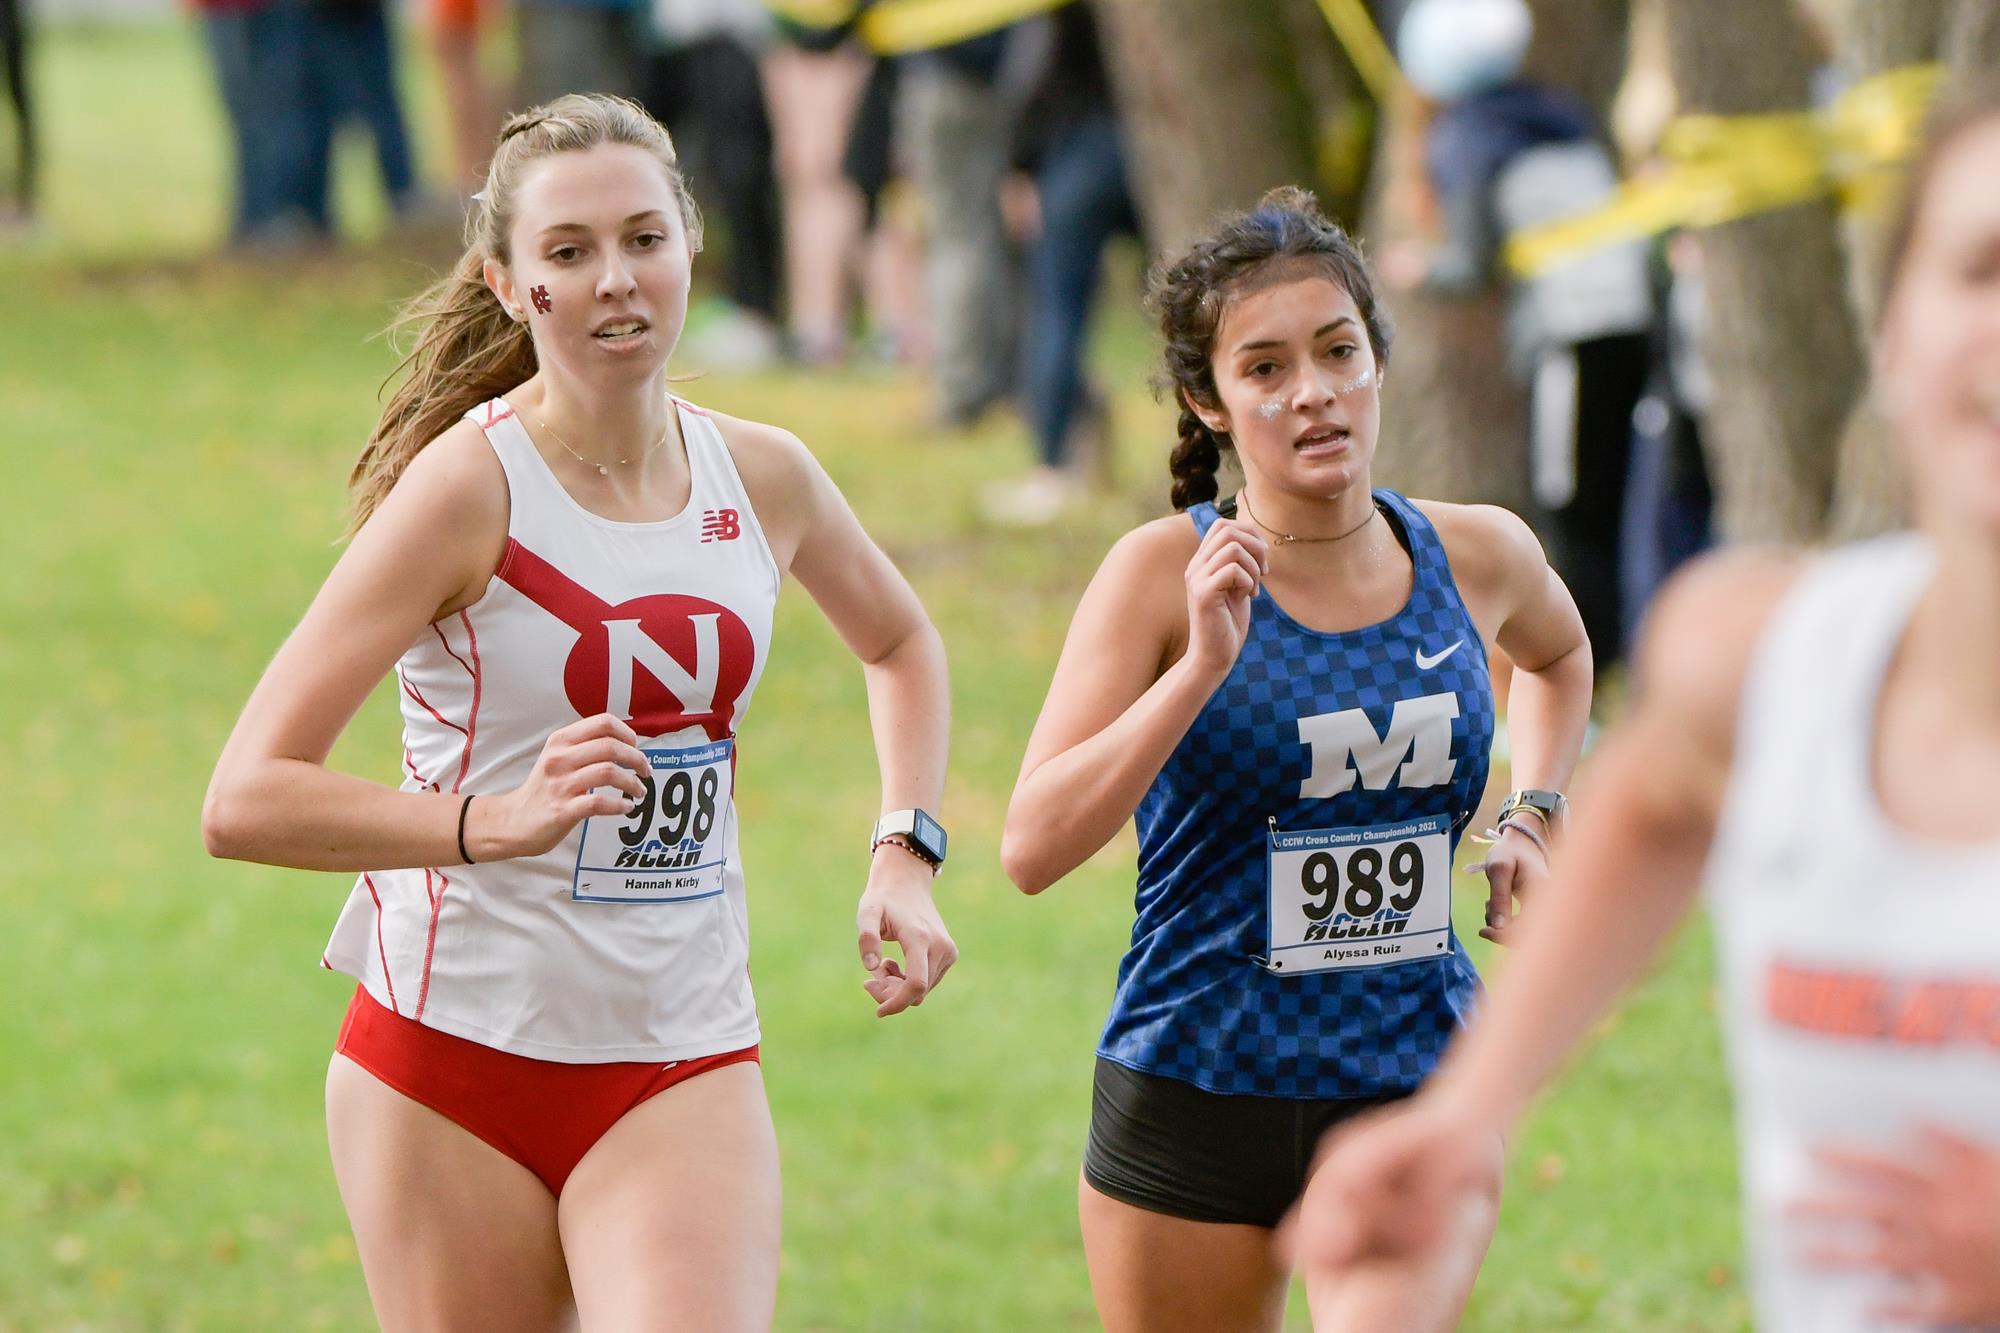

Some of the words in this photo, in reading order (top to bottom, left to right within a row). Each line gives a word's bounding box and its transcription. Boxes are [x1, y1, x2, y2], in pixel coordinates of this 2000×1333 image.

[601, 613, 721, 721] N
[653, 754, 681, 765] Country
[1297, 692, 1460, 799] M
[618, 767, 718, 846] 998
[1282, 836, 1304, 847] CCIW
[1305, 835, 1328, 845] Cross
[1330, 832, 1361, 843] Country
[1363, 825, 1417, 841] Championship
[1418, 821, 1437, 832] 2021
[625, 878, 672, 889] Hannah
[675, 876, 699, 888] Kirby
[1301, 842, 1424, 920] 989
[1324, 946, 1369, 960] Alyssa
[1373, 944, 1401, 956] Ruiz
